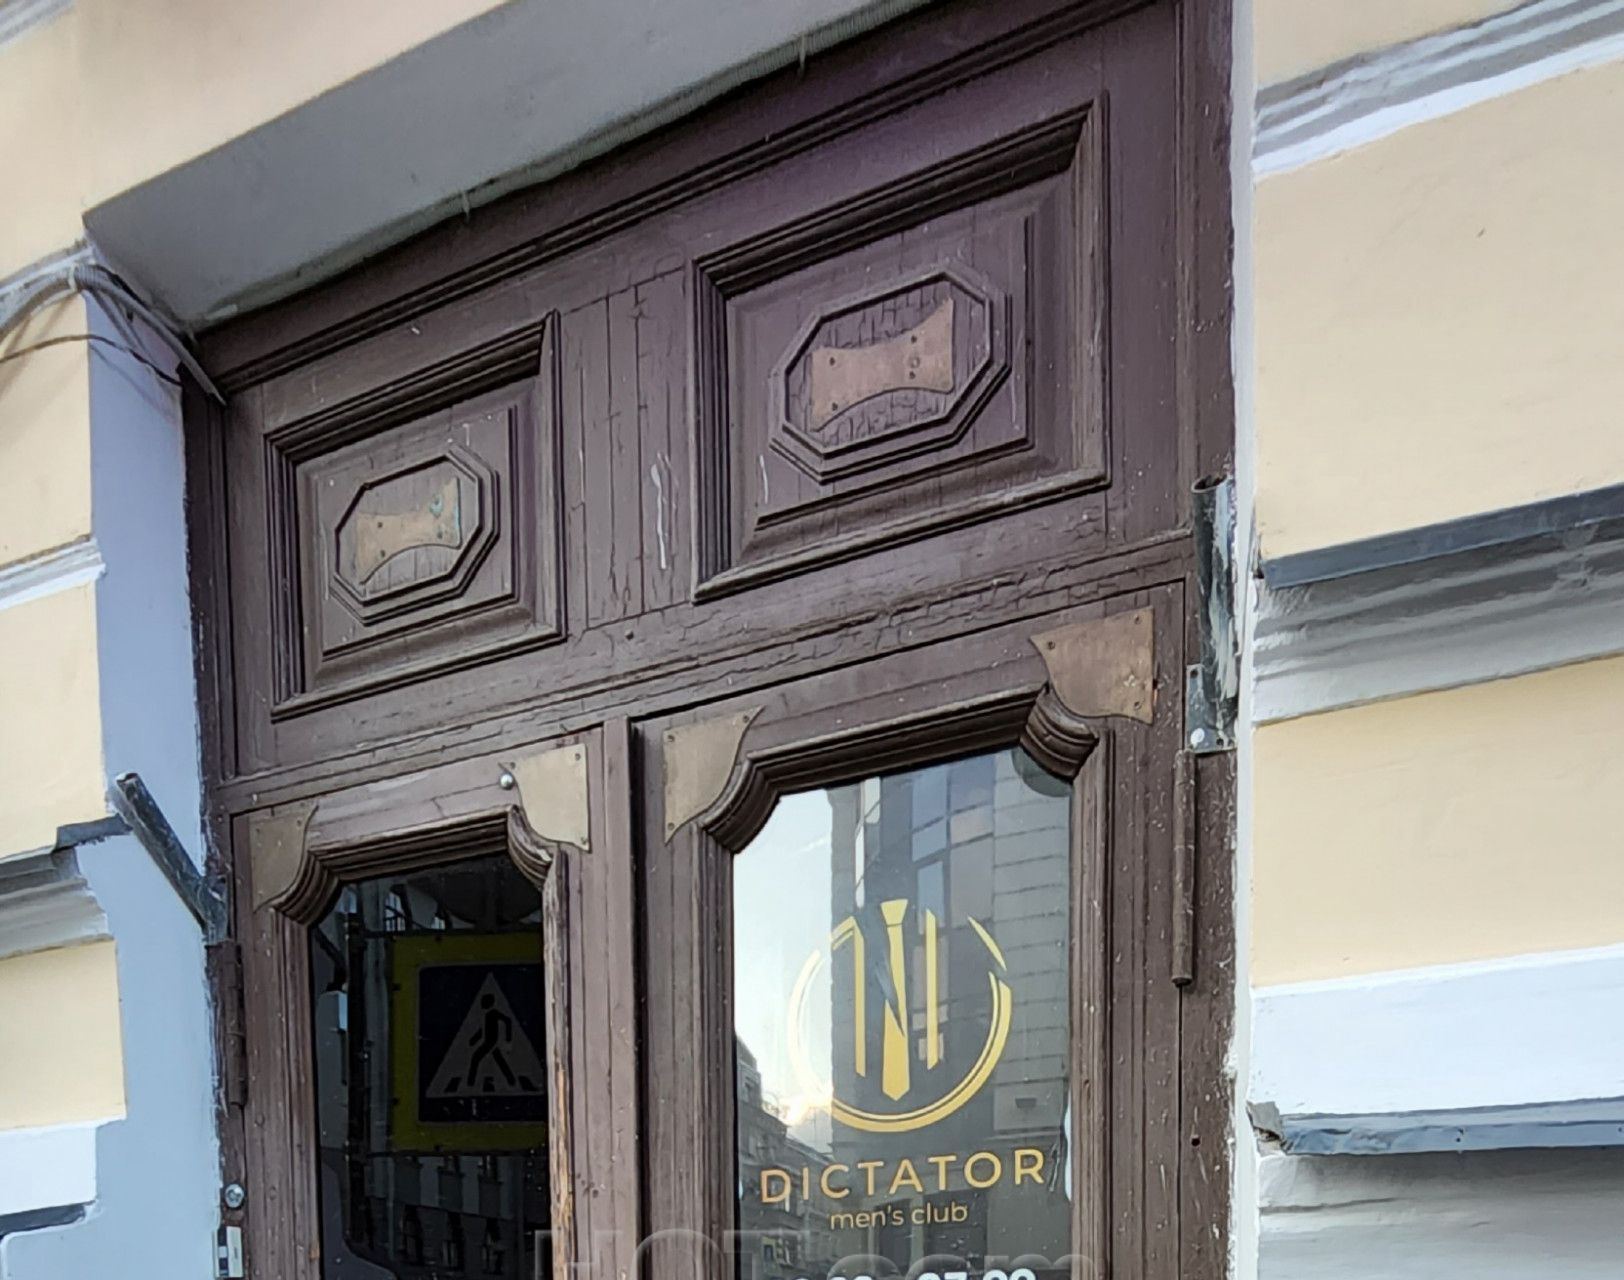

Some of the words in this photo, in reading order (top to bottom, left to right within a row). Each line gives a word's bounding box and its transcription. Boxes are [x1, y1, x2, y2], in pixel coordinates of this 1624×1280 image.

[760, 1148, 1046, 1204] DICTATOR
[829, 1207, 904, 1231] men's
[910, 1202, 968, 1225] club
